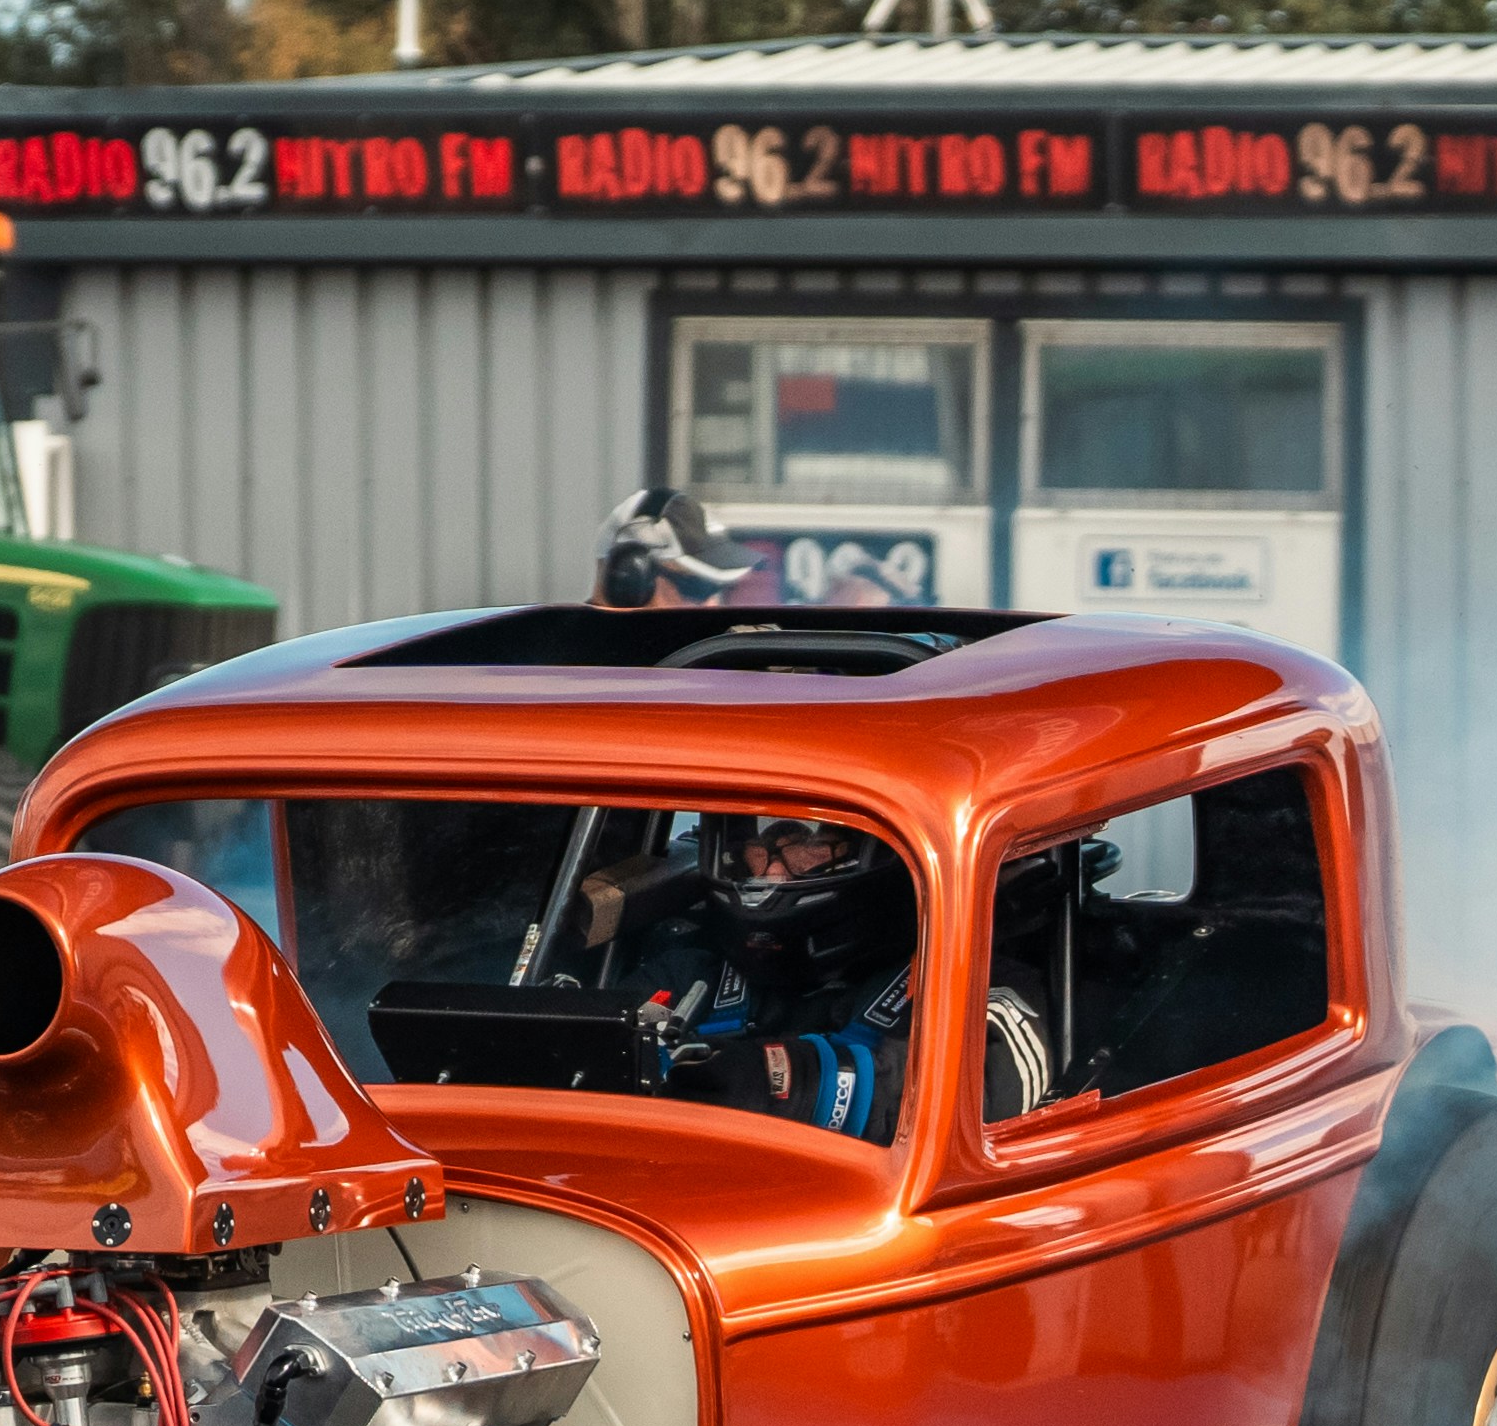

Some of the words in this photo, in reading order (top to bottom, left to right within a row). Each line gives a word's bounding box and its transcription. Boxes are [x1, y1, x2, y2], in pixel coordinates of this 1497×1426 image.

[140, 126, 270, 209] 96.2
[440, 131, 513, 197] FM
[712, 123, 841, 206] 96.2
[1017, 128, 1091, 196] FM
[1296, 122, 1428, 204] 96.2
